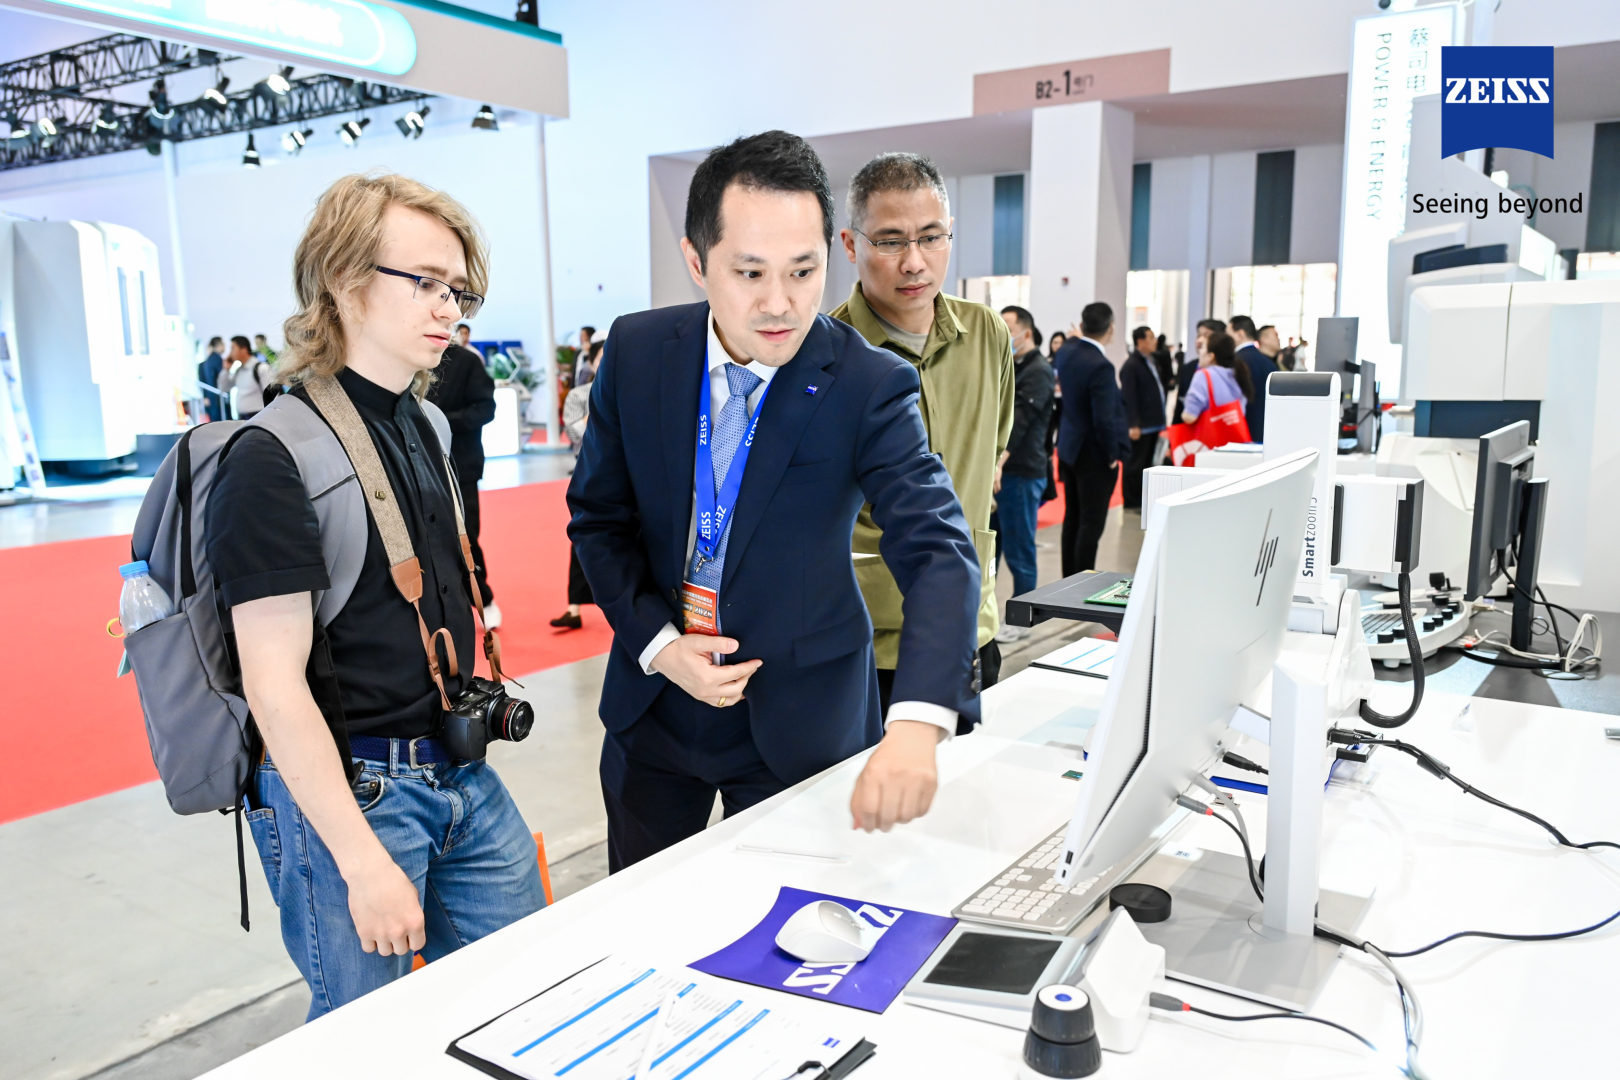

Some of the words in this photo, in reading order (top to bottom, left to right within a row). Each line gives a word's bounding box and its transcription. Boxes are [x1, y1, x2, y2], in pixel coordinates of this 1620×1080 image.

[1373, 32, 1392, 109] POWER
[1371, 118, 1387, 131] &
[1367, 140, 1385, 221] ENERGY
[701, 511, 711, 540] ZEISS
[715, 505, 726, 534] ZEIS
